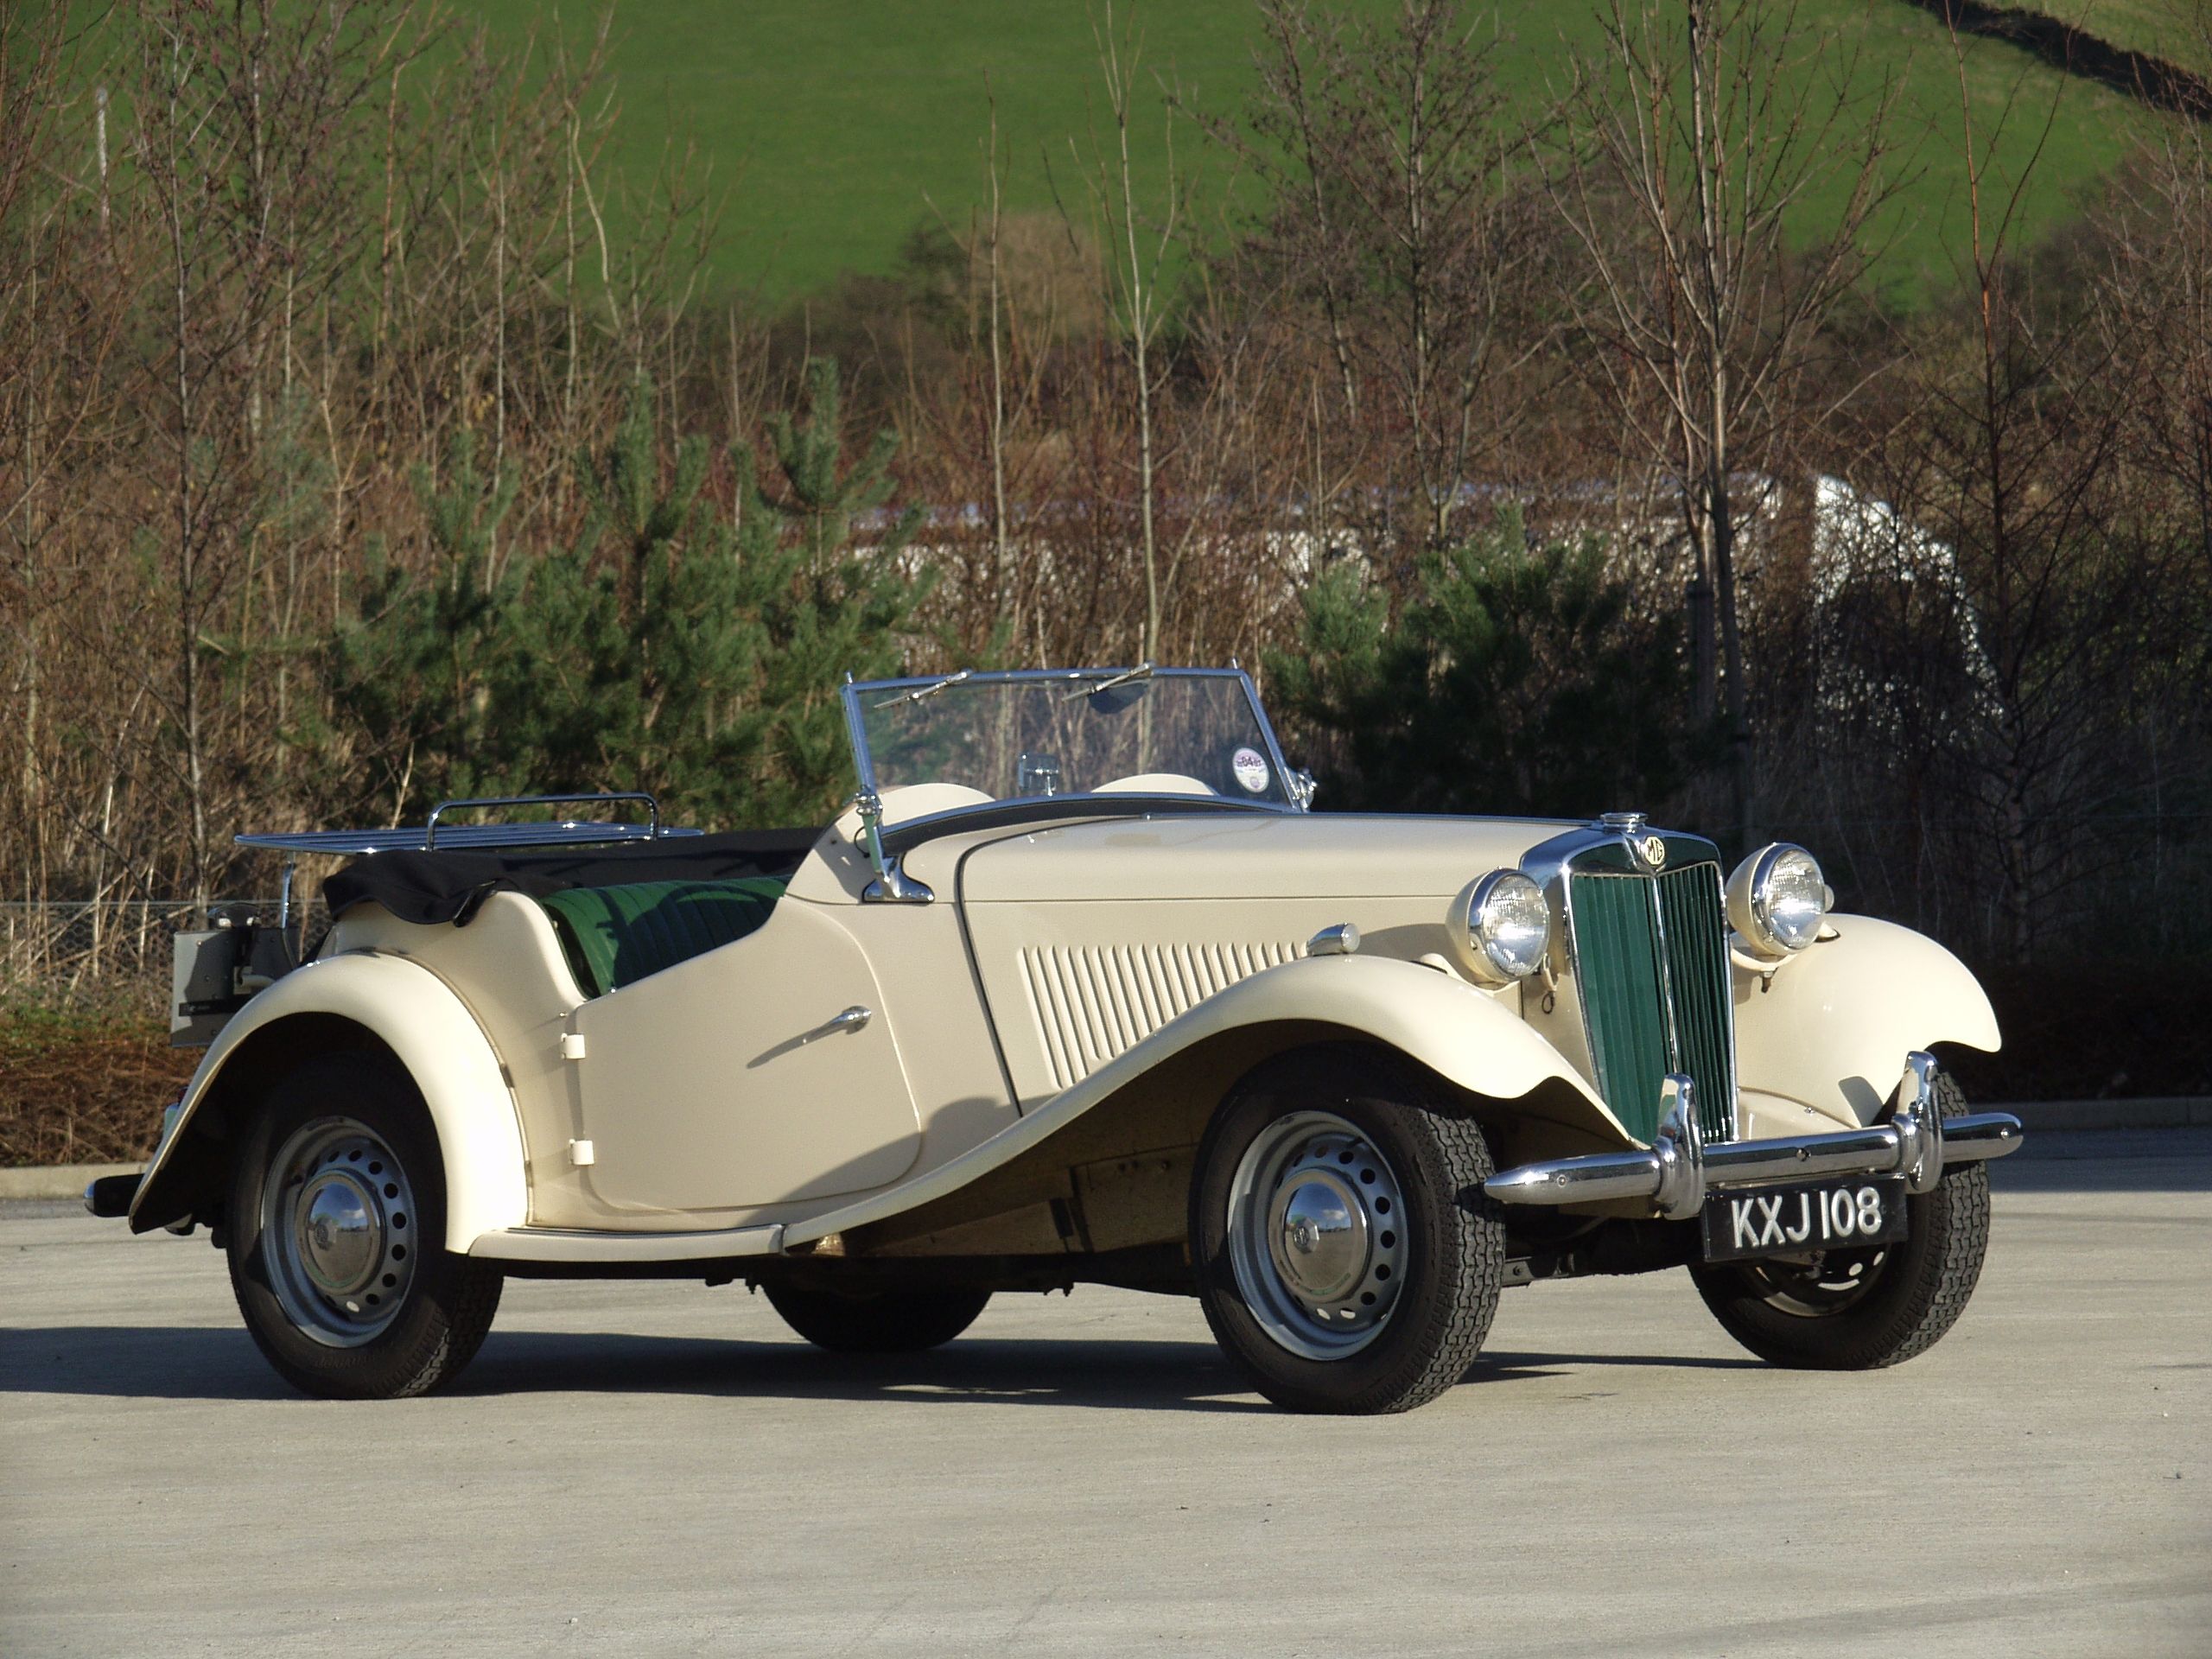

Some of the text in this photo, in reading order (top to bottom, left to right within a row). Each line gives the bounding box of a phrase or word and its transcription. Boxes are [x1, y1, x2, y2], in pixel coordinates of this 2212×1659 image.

[1646, 838, 1664, 863] MG
[1731, 1186, 1882, 1249] KXJ 108
